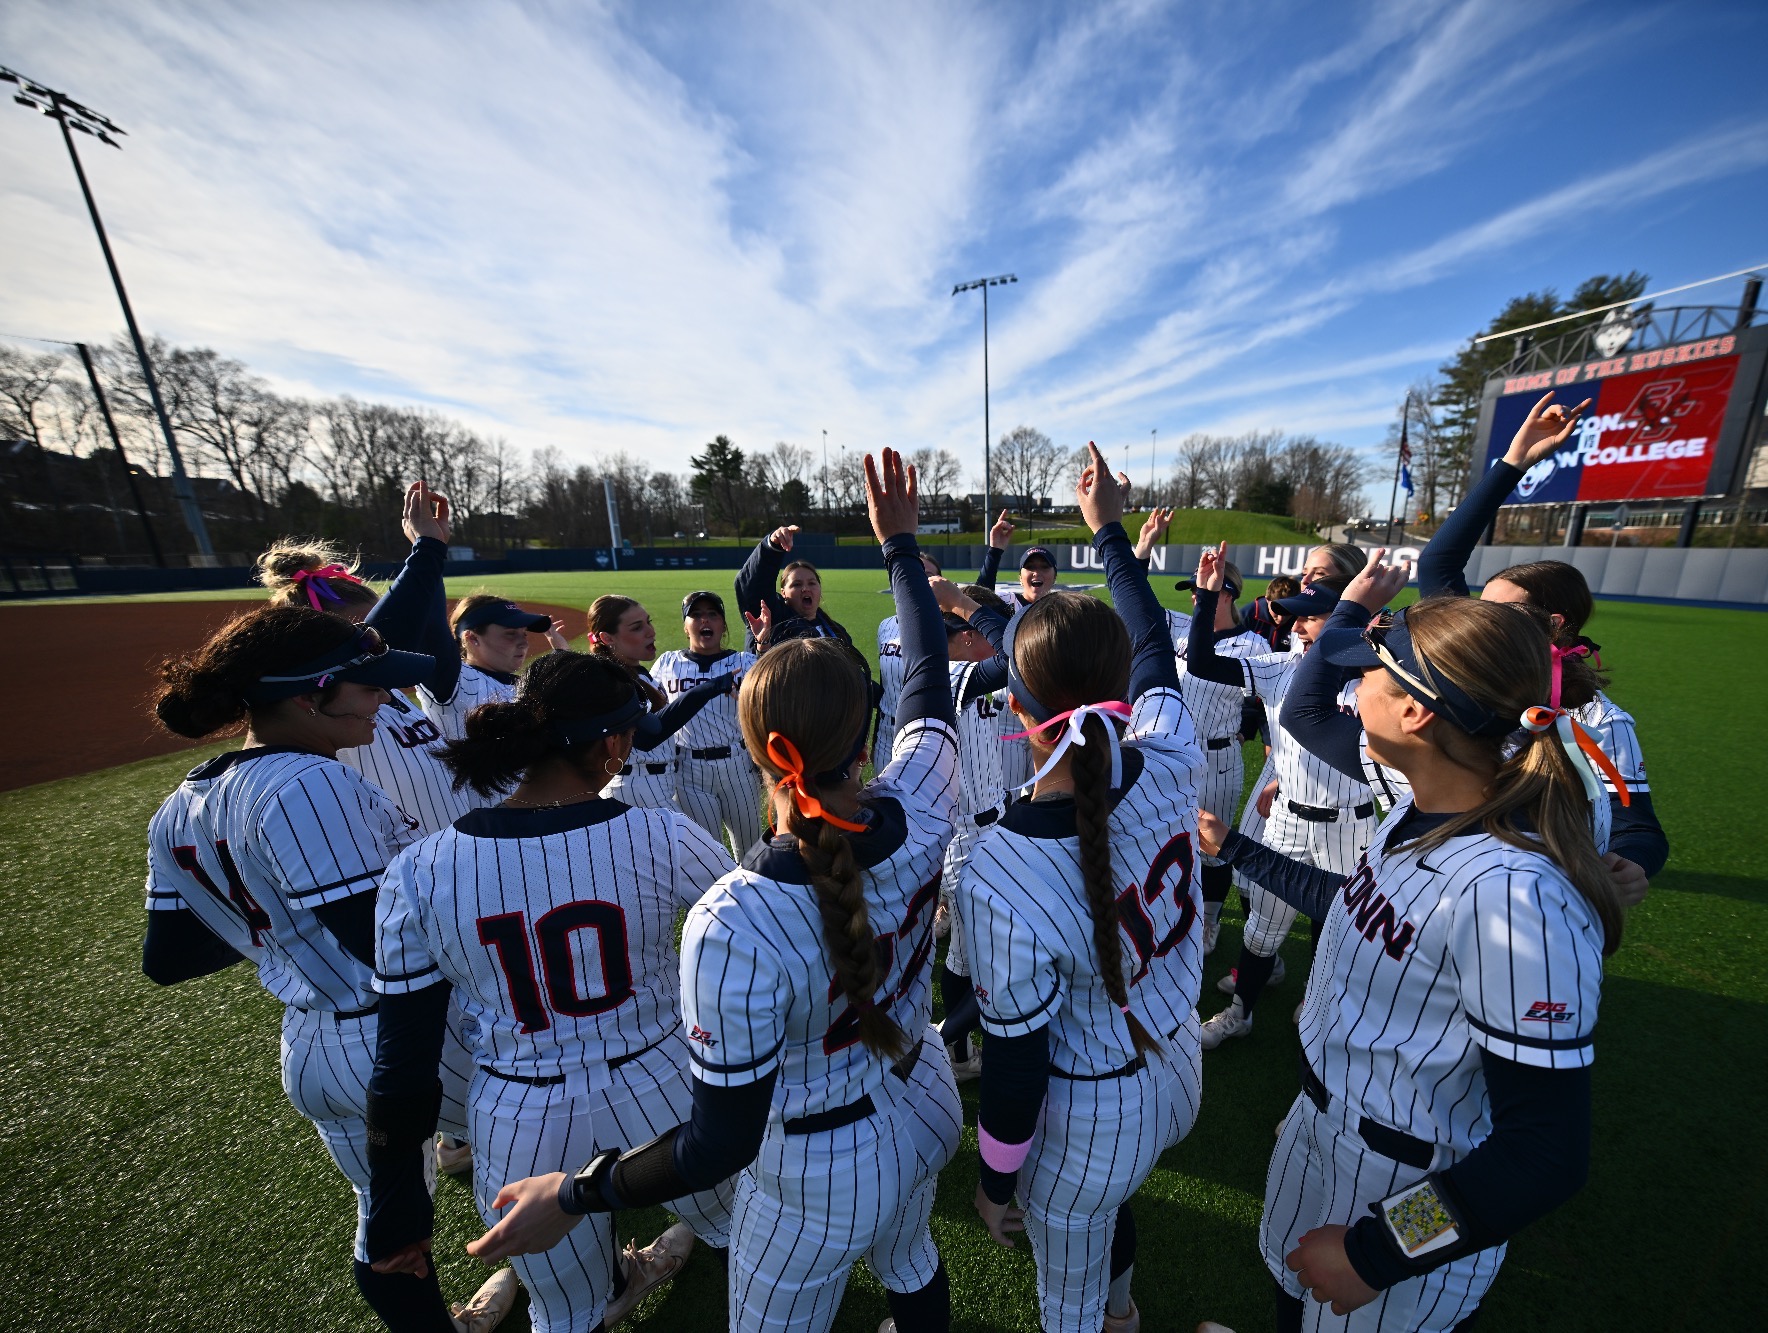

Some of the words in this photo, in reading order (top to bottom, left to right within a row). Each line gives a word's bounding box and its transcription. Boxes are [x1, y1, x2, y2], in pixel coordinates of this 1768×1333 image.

[1503, 371, 1552, 394] HOME
[1556, 365, 1581, 385] OF
[1585, 356, 1626, 380] THE
[1629, 335, 1737, 371] HUSKIES
[1582, 437, 1708, 467] COLLEGE
[1071, 545, 1167, 570] UCN
[171, 838, 273, 948] 14
[1113, 832, 1197, 989] 13
[476, 899, 637, 1035] 10
[1524, 1009, 1576, 1021] EAST
[1530, 1001, 1568, 1012] BIG
